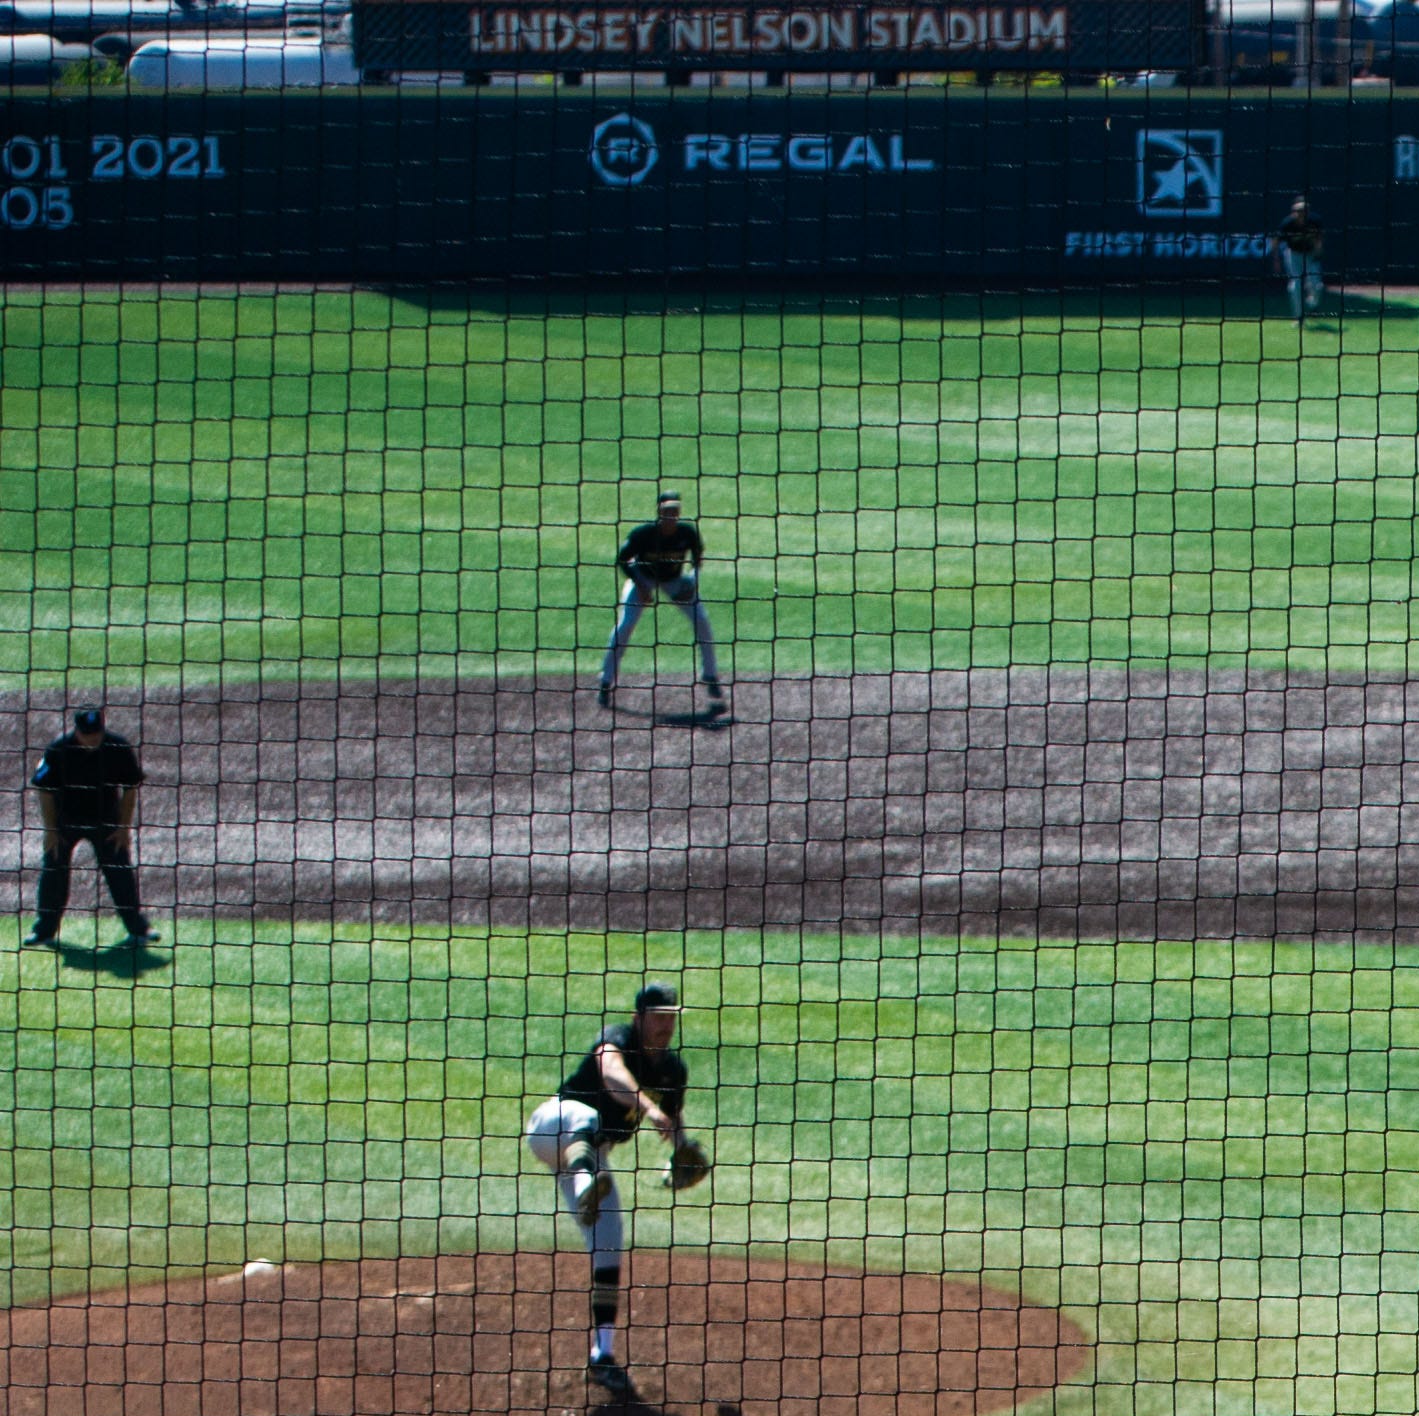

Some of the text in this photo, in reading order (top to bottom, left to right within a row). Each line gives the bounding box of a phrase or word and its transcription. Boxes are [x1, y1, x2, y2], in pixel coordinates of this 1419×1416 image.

[470, 8, 1067, 53] LINDSEY NELSON STADIUM
[91, 133, 226, 180] 2021
[685, 133, 934, 171] REGAL
[1064, 230, 1270, 260] FIRST HORIZO
